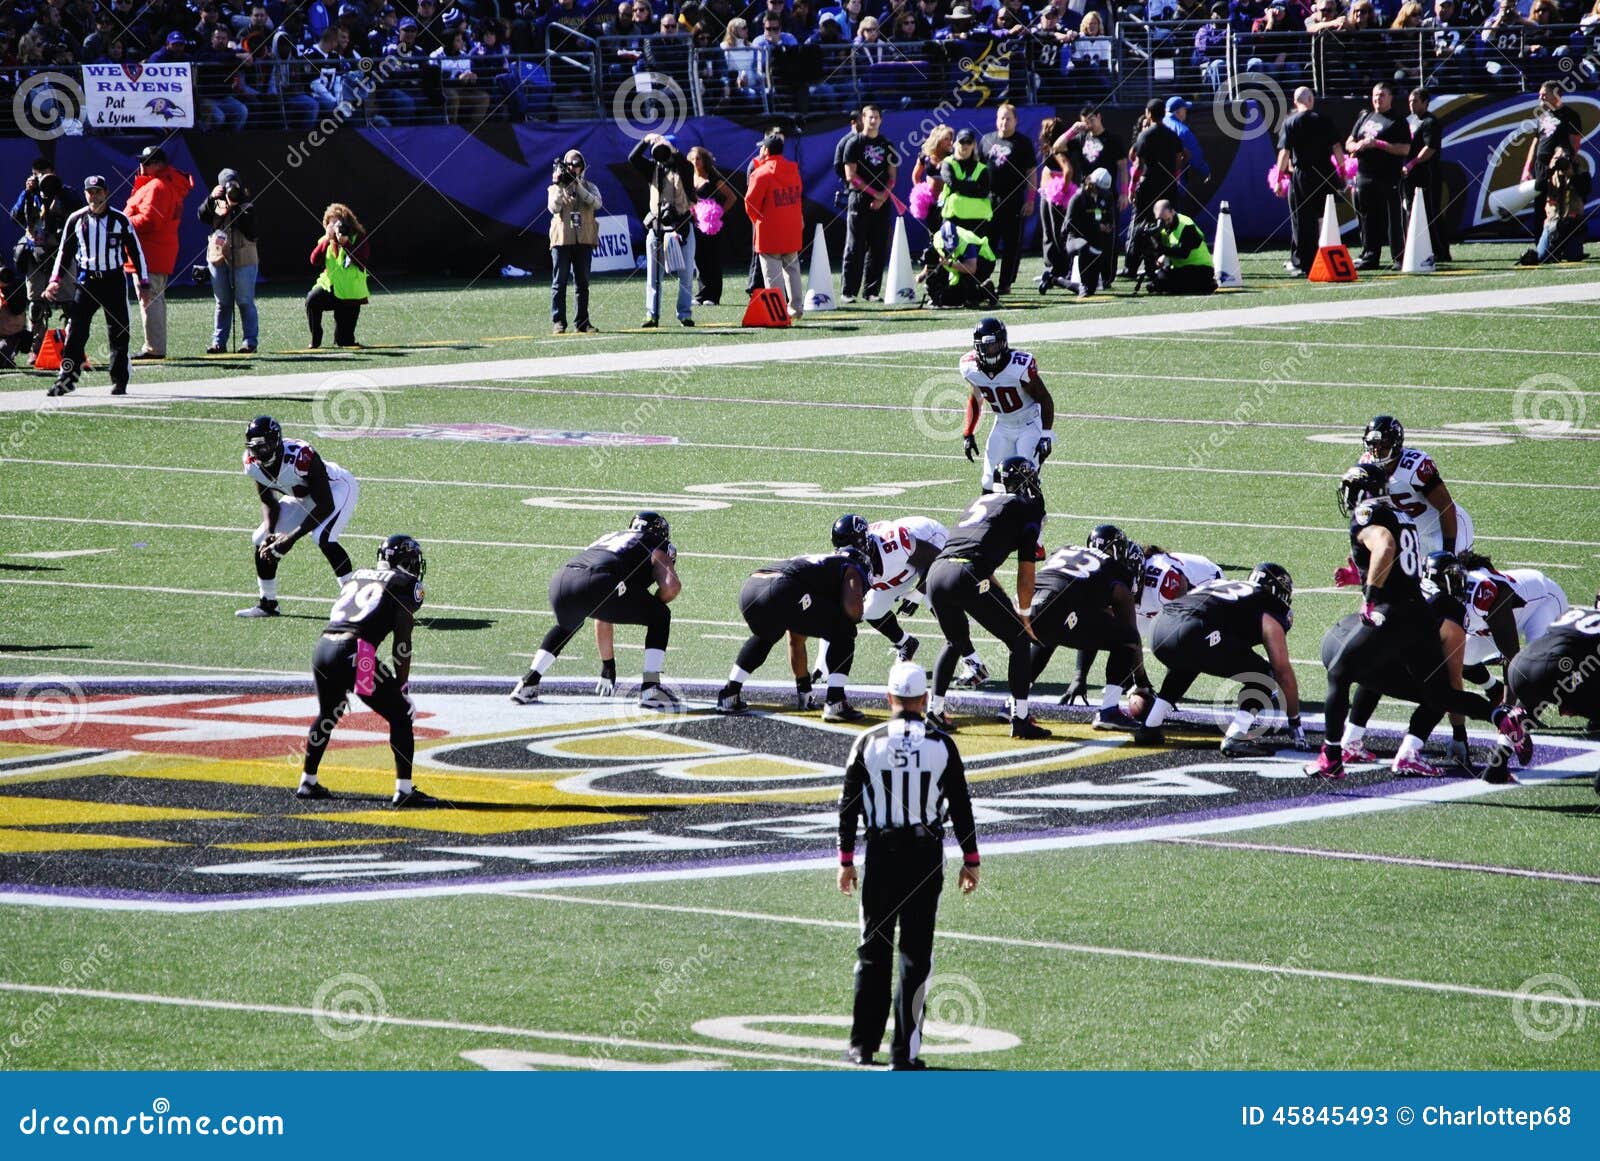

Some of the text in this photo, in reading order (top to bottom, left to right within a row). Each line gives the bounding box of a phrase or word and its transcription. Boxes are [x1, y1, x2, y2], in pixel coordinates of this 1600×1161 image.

[85, 66, 188, 77] WE OUR
[97, 81, 183, 92] RAVENS
[105, 96, 126, 108] Pat
[97, 111, 136, 125] & Lynn
[1328, 249, 1351, 276] G
[761, 292, 787, 322] 10
[979, 386, 1024, 414] 20
[1400, 527, 1422, 578] 8
[330, 580, 384, 624] 29
[894, 748, 921, 769] 51
